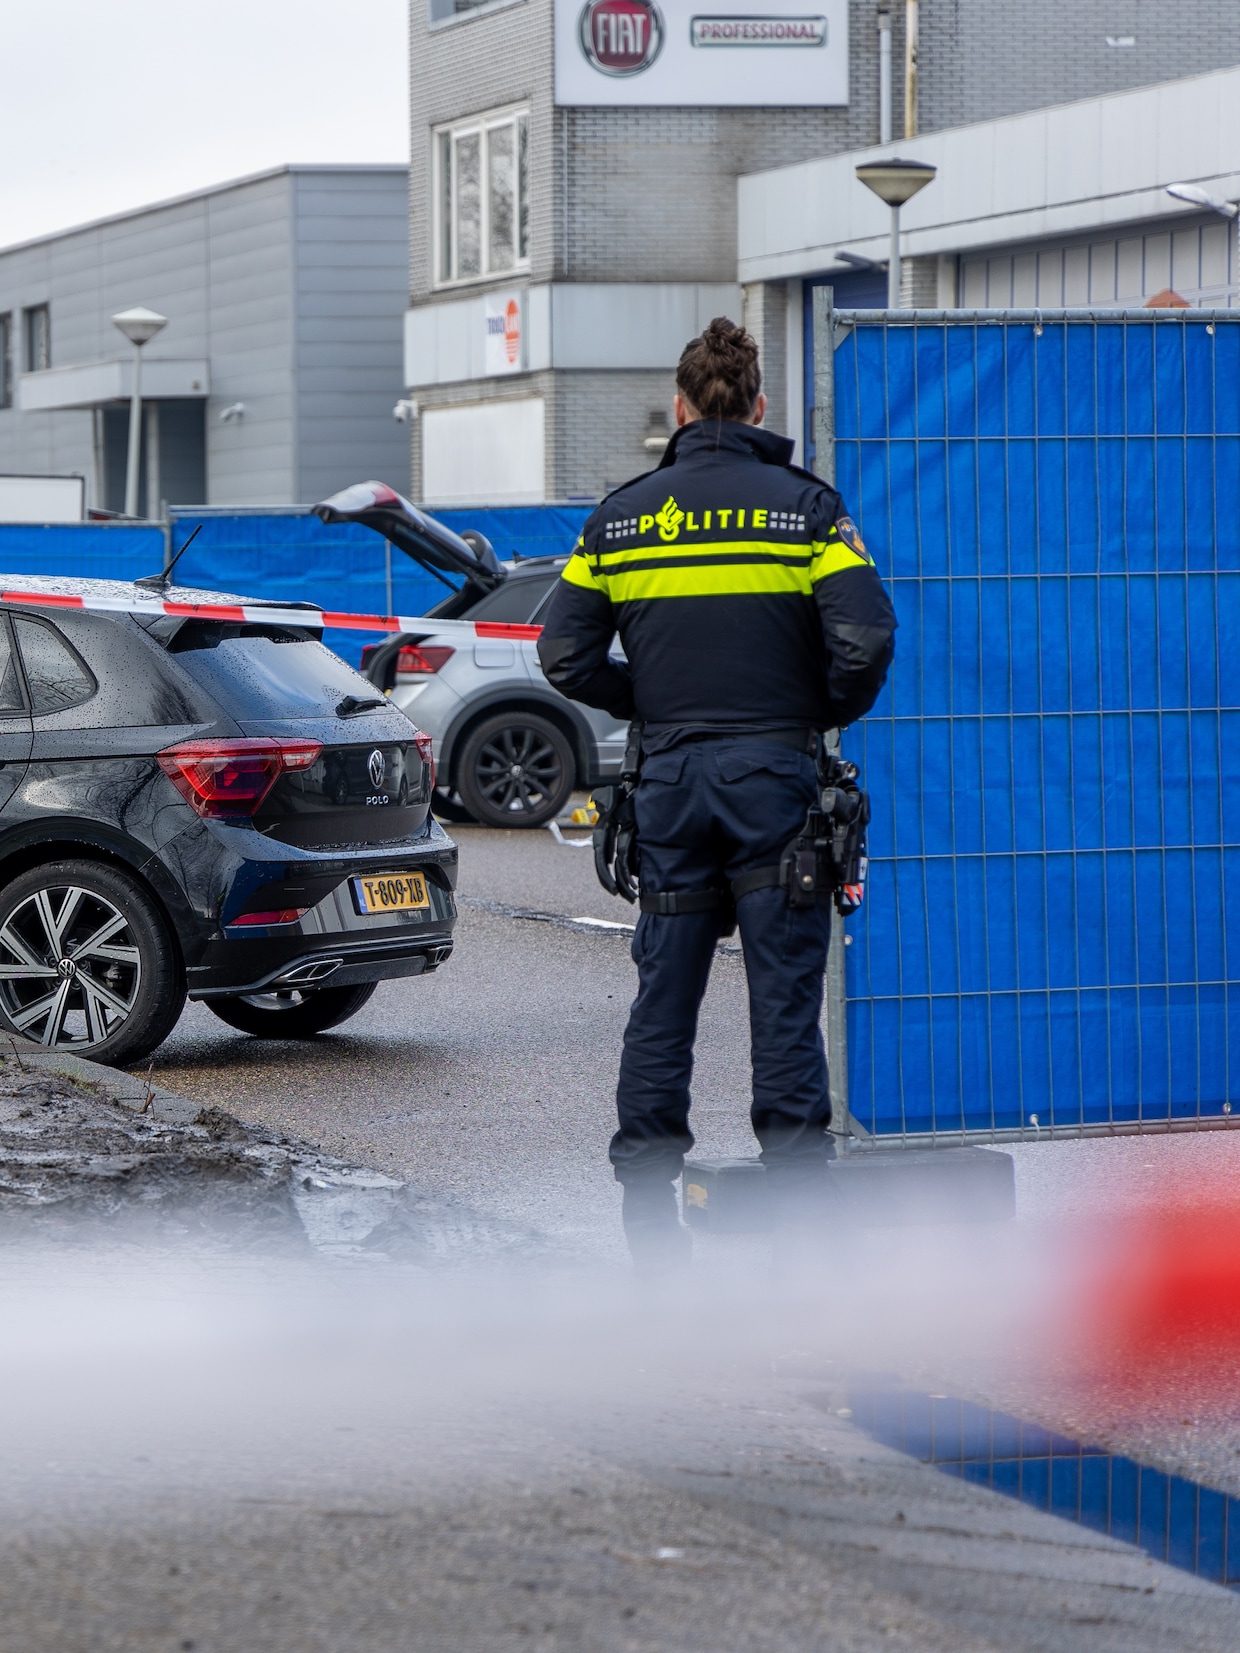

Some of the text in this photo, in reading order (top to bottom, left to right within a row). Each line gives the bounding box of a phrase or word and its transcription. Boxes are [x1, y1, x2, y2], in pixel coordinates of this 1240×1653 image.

[596, 13, 648, 54] FIAT
[700, 23, 818, 40] PROFESSIONAL
[639, 496, 769, 541] POLITIE
[366, 795, 390, 806] POLO
[365, 877, 425, 907] T-809-XB
